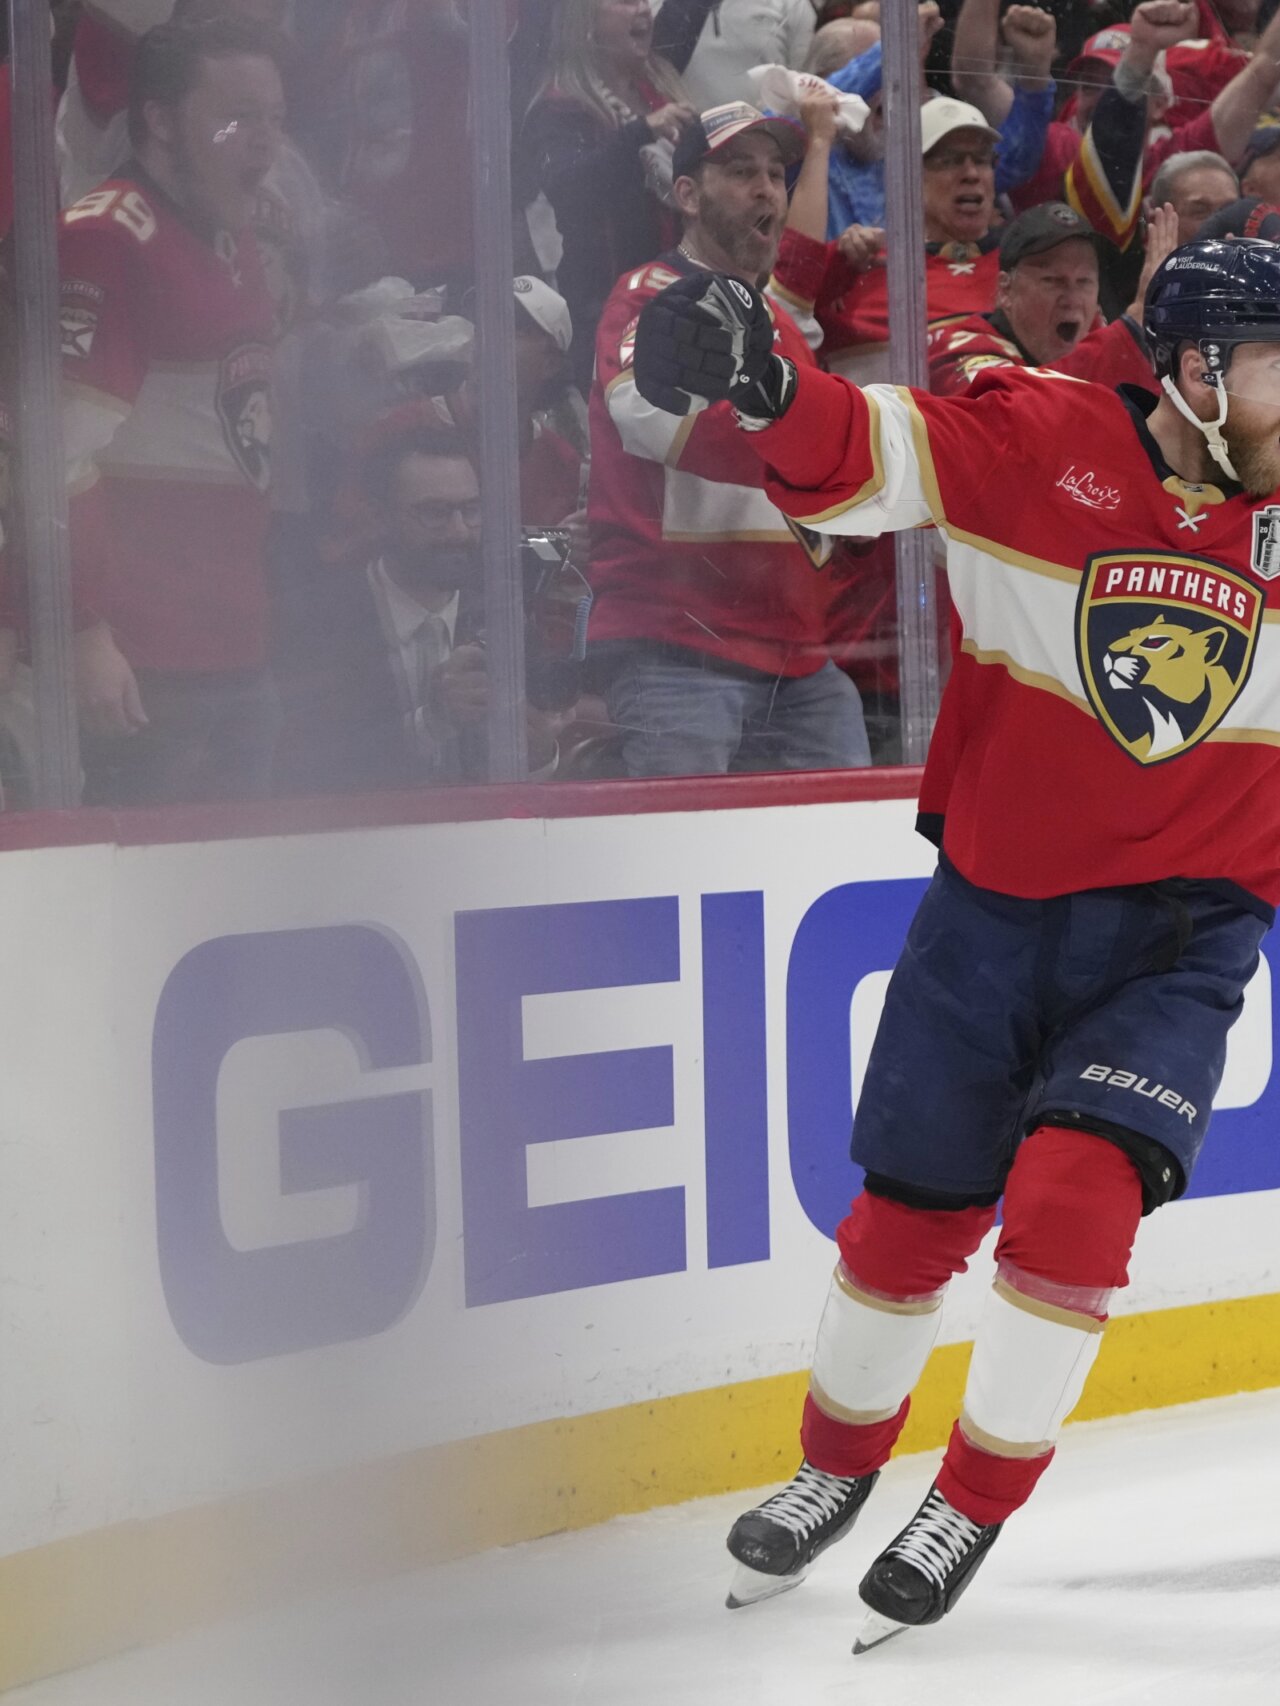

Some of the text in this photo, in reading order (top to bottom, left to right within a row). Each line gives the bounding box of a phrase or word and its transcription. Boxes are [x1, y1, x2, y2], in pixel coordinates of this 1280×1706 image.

[1174, 262, 1220, 272] LAUDERDALE
[1056, 465, 1121, 510] LaCroix
[1259, 526, 1269, 534] 20
[1105, 567, 1247, 620] PANTHERS
[1079, 1064, 1198, 1125] BAUER
